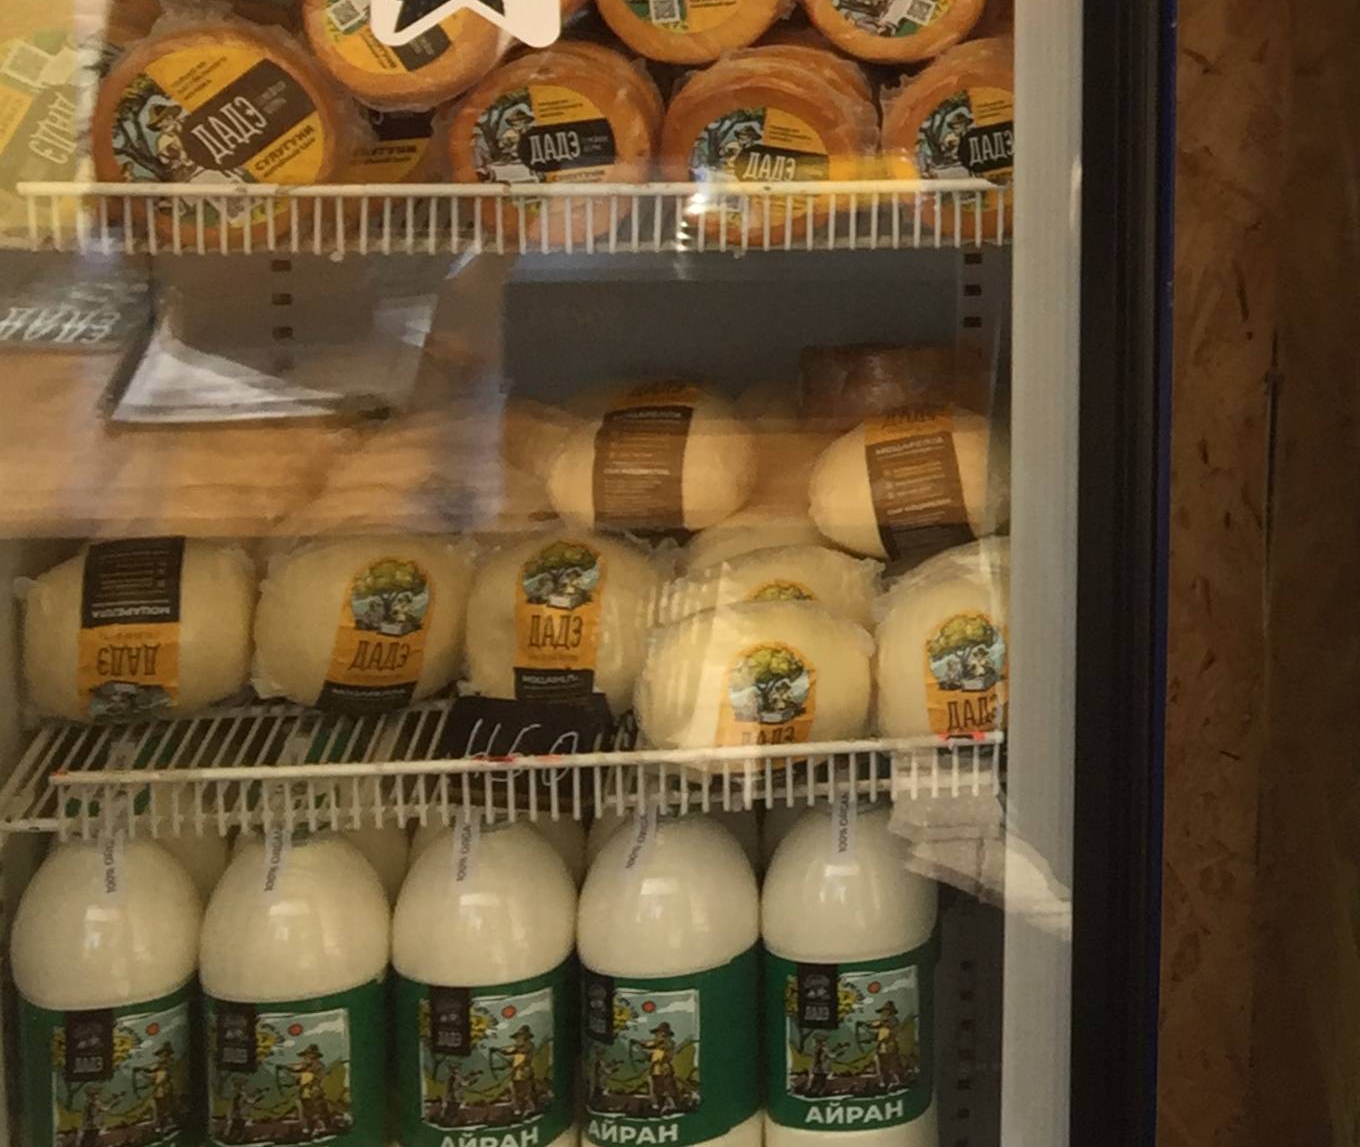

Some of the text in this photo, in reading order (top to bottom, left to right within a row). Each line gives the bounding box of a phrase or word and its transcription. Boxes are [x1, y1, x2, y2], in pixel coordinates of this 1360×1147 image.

[190, 95, 268, 165] ДАДЭ
[529, 131, 581, 165] ДАДЭ
[742, 152, 797, 182] ДАДЭ
[527, 614, 584, 651] ДАДЭ
[96, 642, 161, 677] ДАДЭ
[347, 640, 411, 672] ДАДЭ
[806, 1100, 904, 1126] АЙРАН
[588, 1117, 679, 1145] АЙРАН
